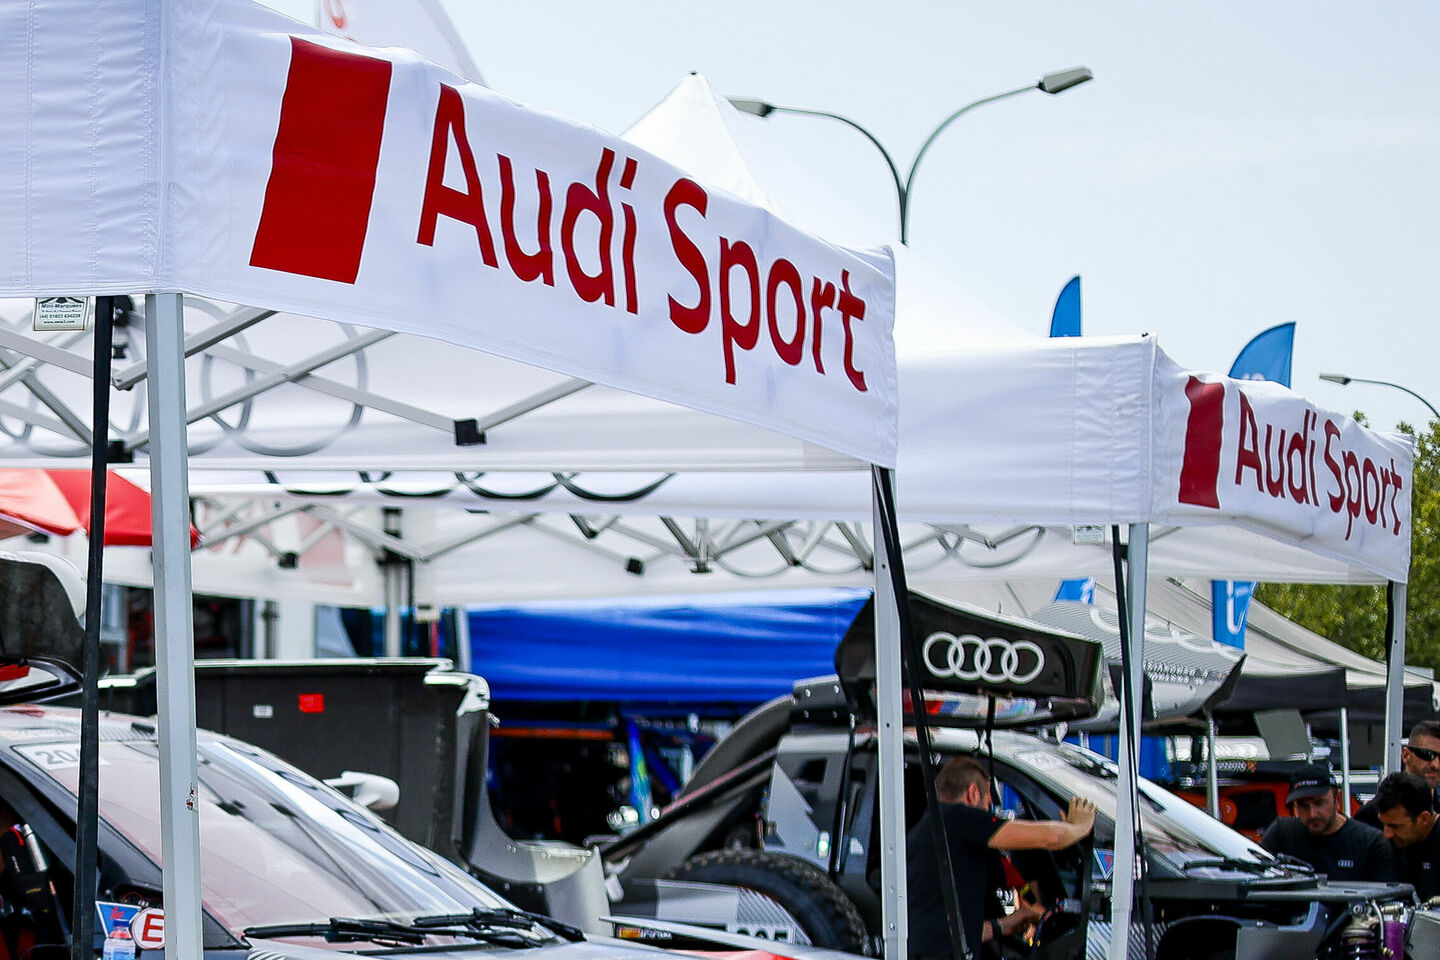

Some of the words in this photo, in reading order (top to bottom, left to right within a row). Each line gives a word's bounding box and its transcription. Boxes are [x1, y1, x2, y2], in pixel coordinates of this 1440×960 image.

[417, 82, 639, 316] Audi
[664, 177, 868, 393] Sport
[1235, 390, 1319, 507] Audi
[1324, 418, 1403, 541] Sport
[35, 748, 80, 765] 20
[142, 913, 166, 943] E
